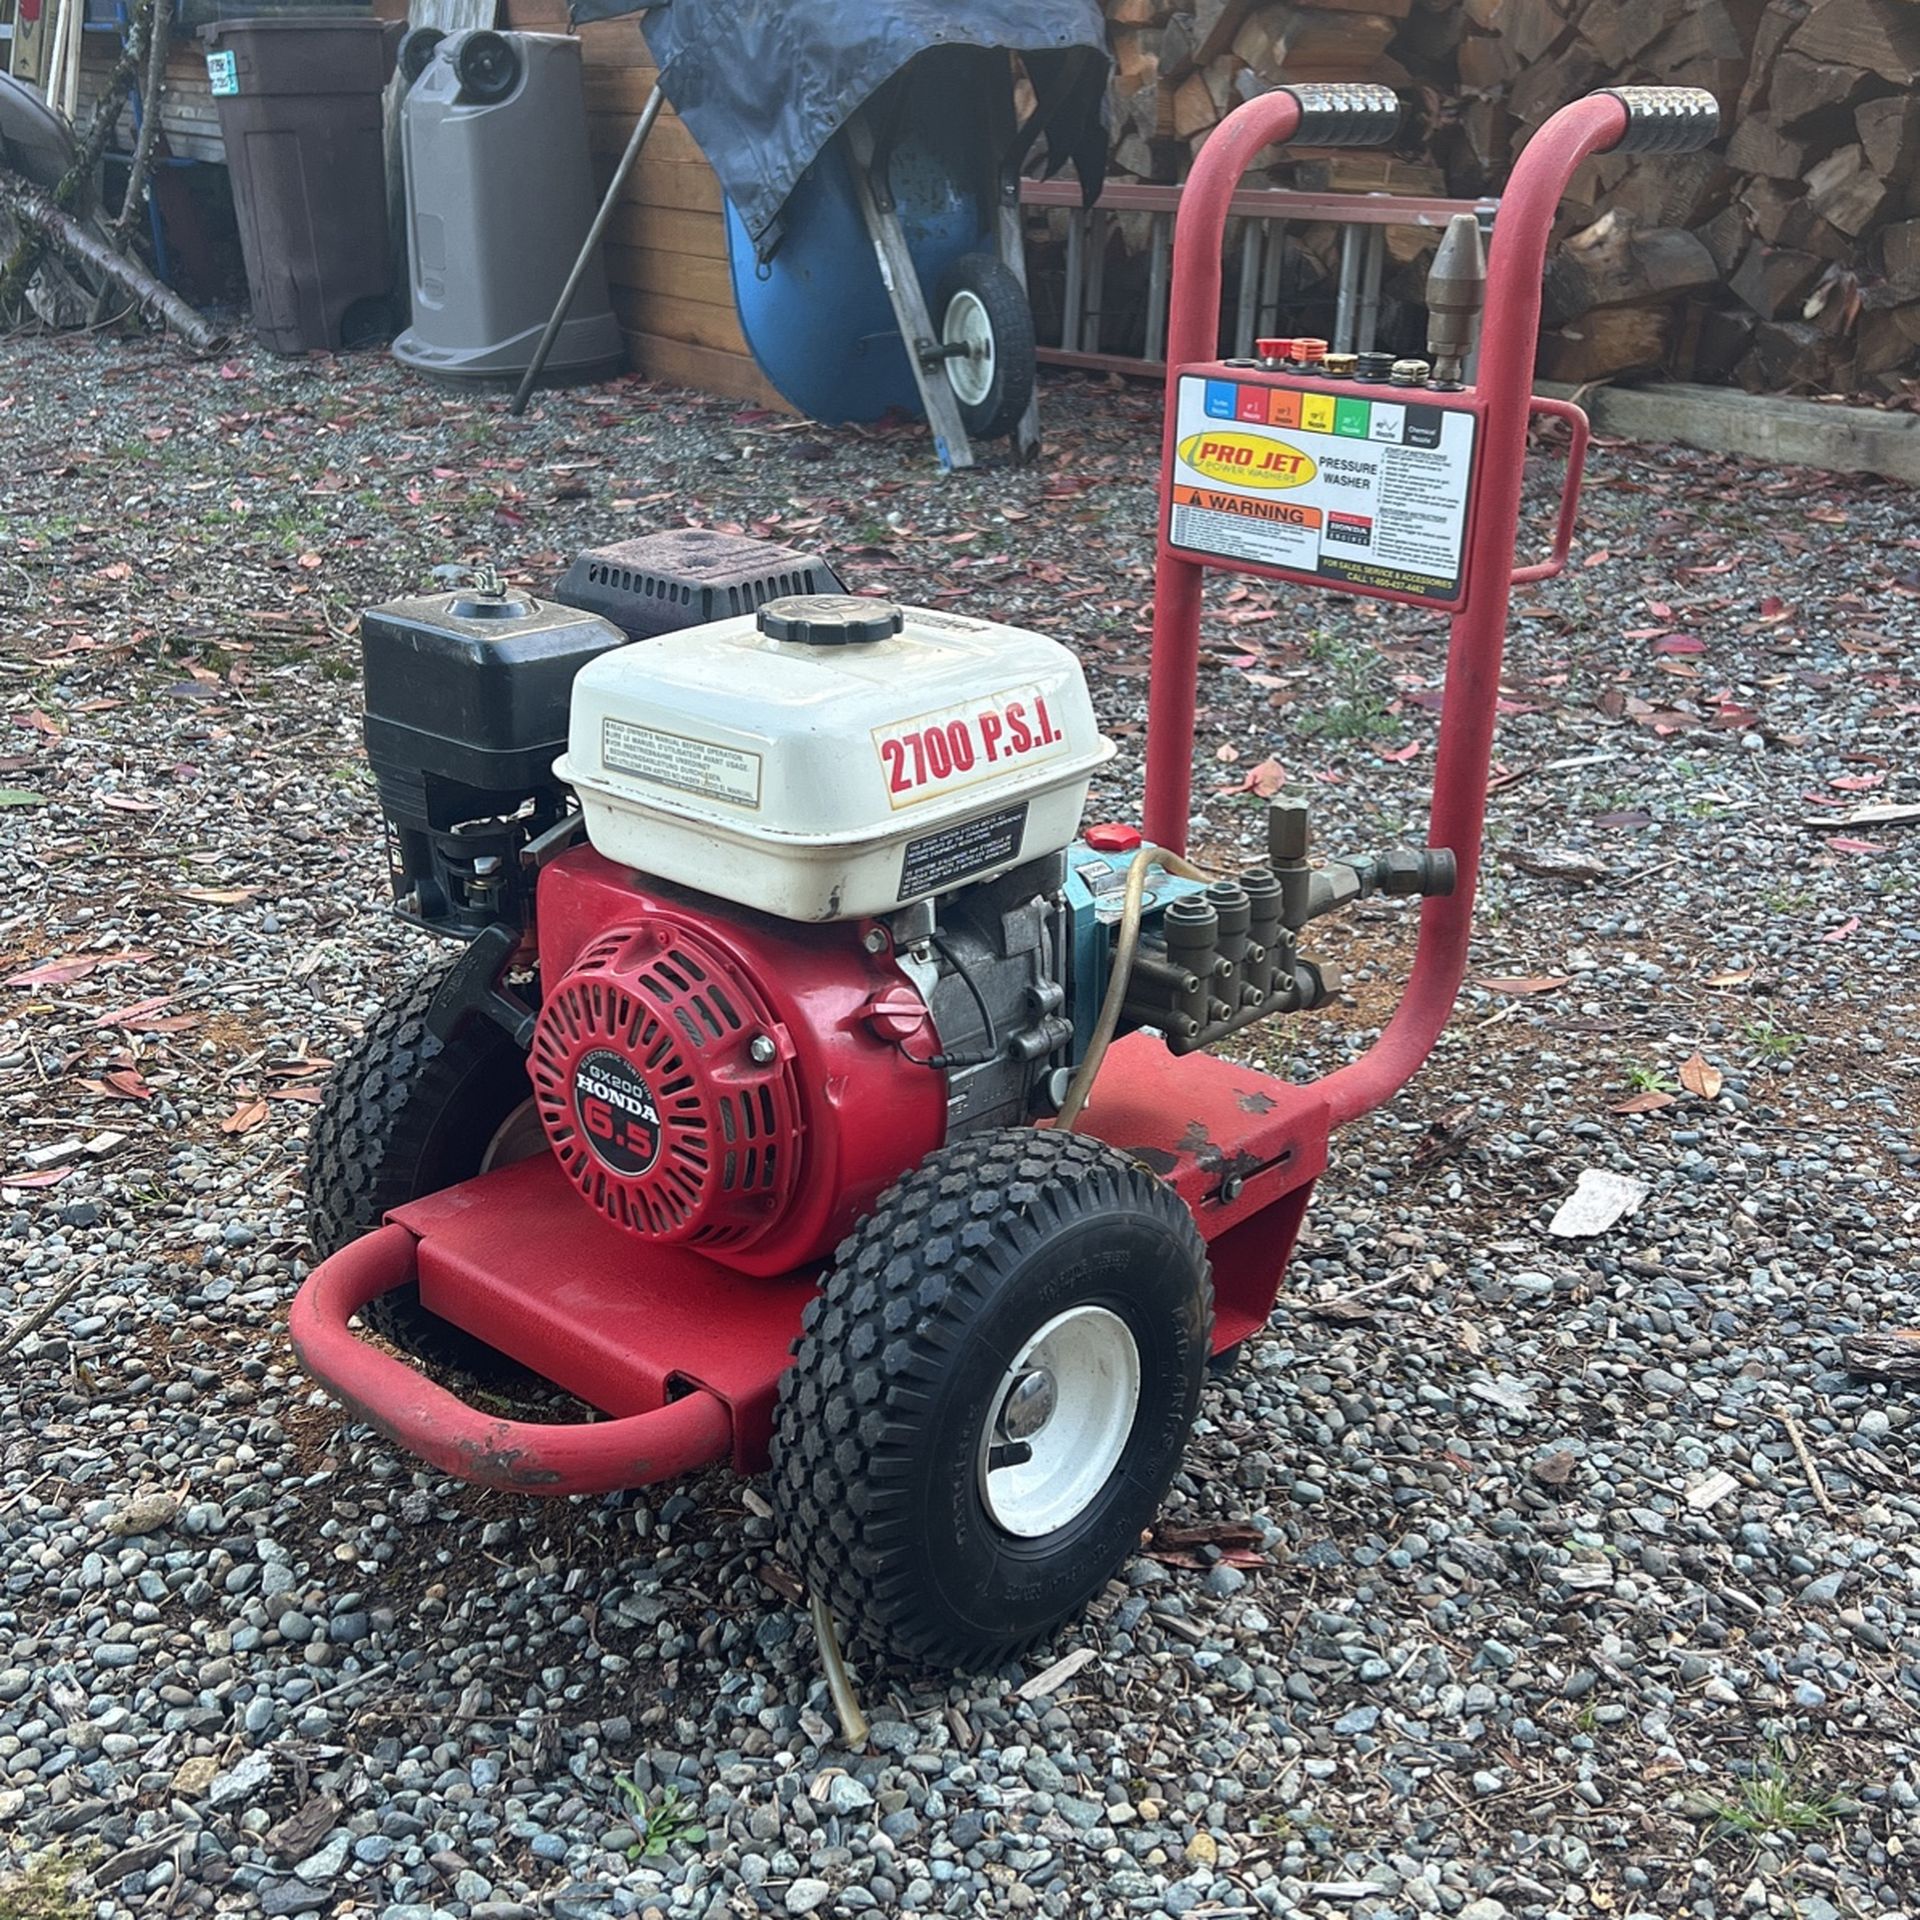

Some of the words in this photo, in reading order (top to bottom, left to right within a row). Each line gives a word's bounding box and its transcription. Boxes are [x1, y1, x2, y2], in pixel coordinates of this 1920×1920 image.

[1200, 442, 1252, 466] PRO
[1256, 452, 1305, 474] JET
[1206, 461, 1245, 476] POWER
[1319, 457, 1378, 476] PRESSURE
[1324, 473, 1371, 490] WASHER
[1209, 495, 1304, 524] WARNING
[1330, 523, 1368, 535] HONDA
[882, 720, 975, 793] 2700
[979, 696, 1062, 762] P.S.I.
[589, 1065, 643, 1099] GX200
[576, 1073, 660, 1125] HONDA
[584, 1097, 652, 1158] 6.5
